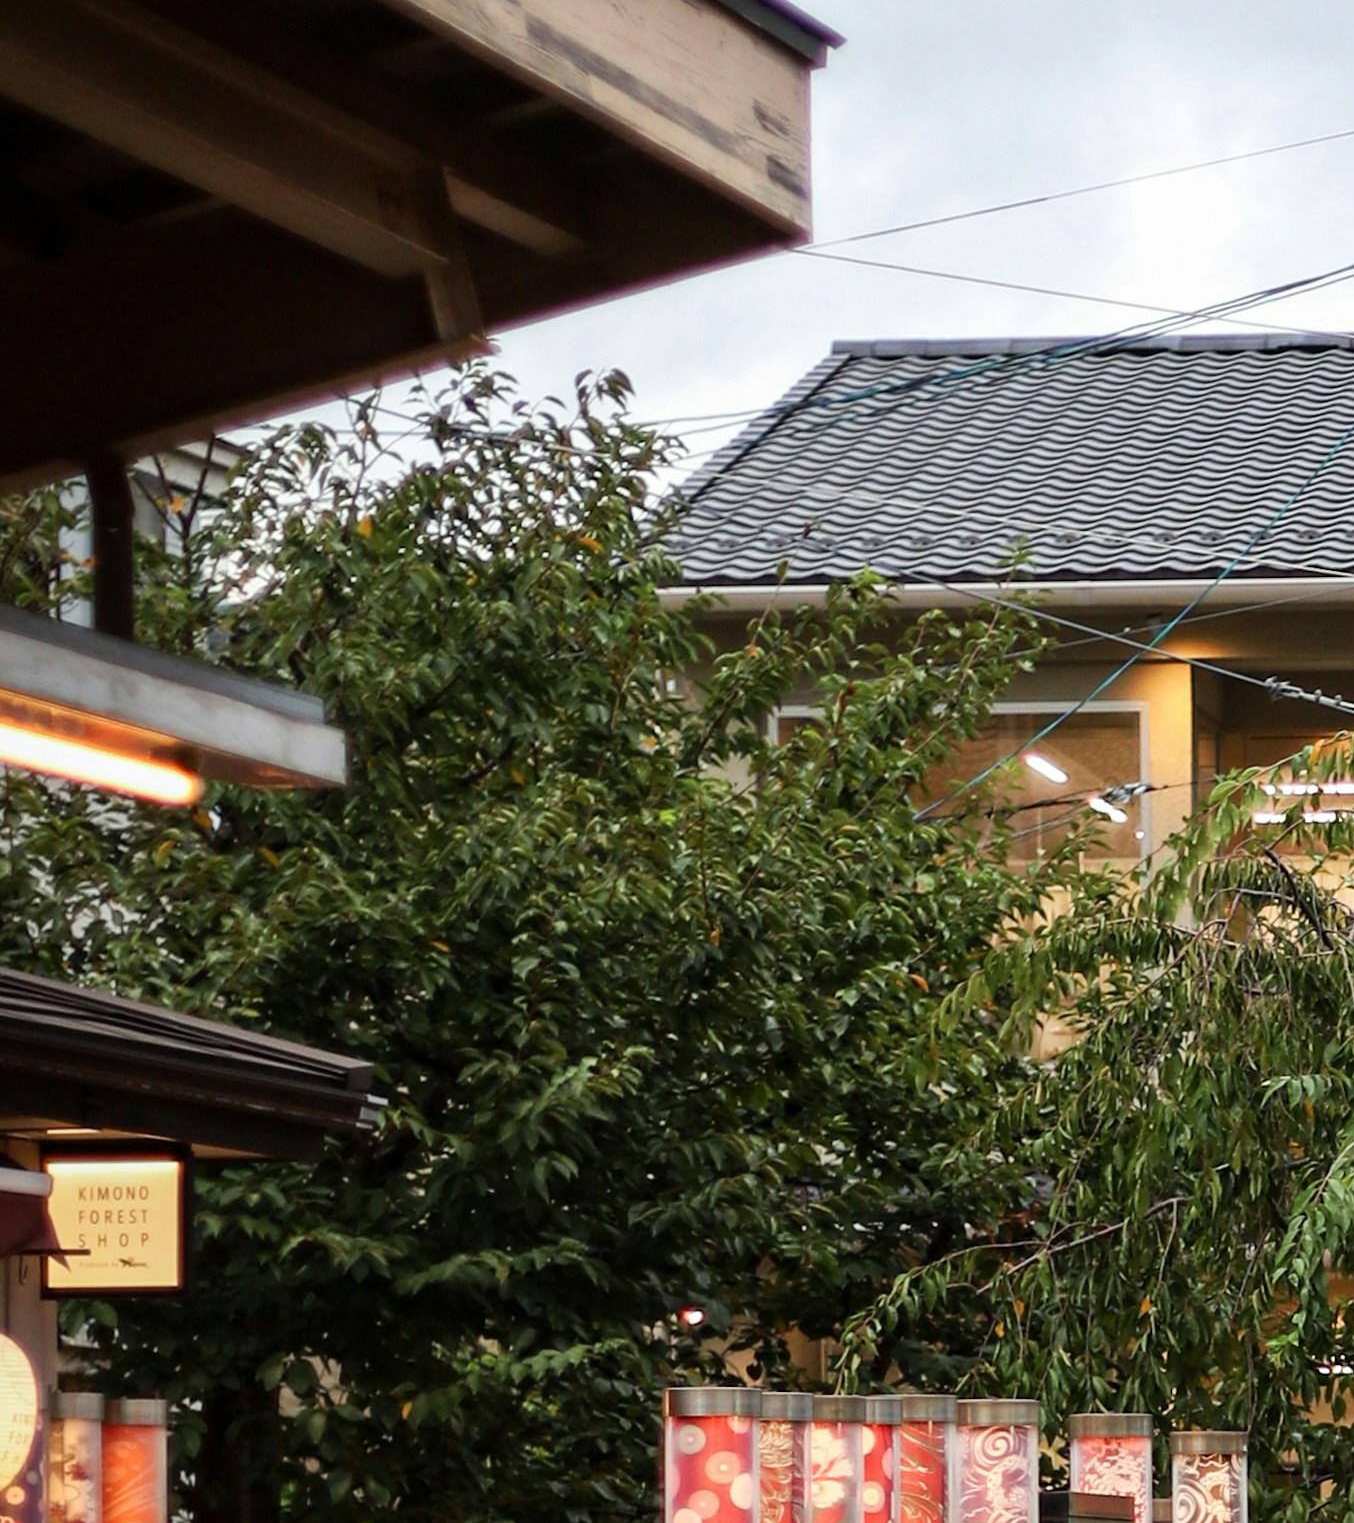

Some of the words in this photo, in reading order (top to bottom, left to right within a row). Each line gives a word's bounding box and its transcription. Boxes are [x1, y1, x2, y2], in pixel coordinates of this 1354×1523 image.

[78, 1185, 149, 1201] KIMONO
[78, 1209, 148, 1225] FOREST
[78, 1233, 149, 1248] SHOP
